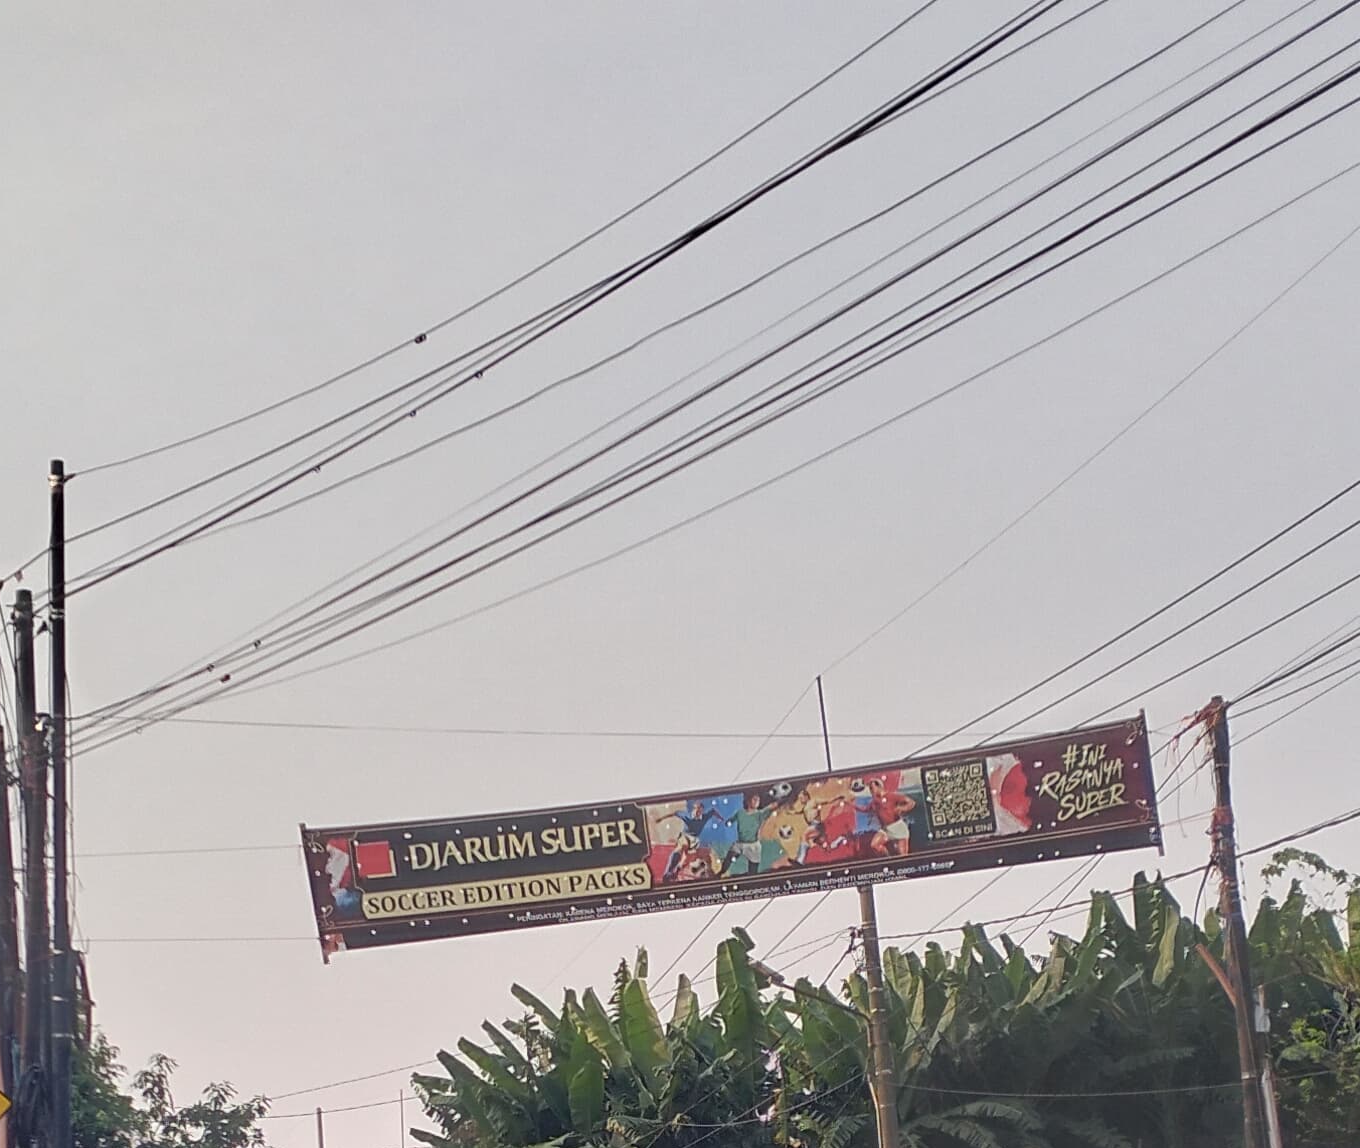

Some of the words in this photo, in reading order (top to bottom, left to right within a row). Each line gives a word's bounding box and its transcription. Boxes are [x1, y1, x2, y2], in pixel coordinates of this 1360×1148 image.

[1039, 758, 1124, 800] RASANYA
[1061, 744, 1107, 772] #INI
[1057, 783, 1128, 820] SUPER
[407, 831, 537, 871] DJARUM
[540, 819, 642, 854] SUPER
[367, 885, 460, 915] SOCCER
[463, 877, 561, 905] EDITION
[568, 867, 646, 893] PACKS
